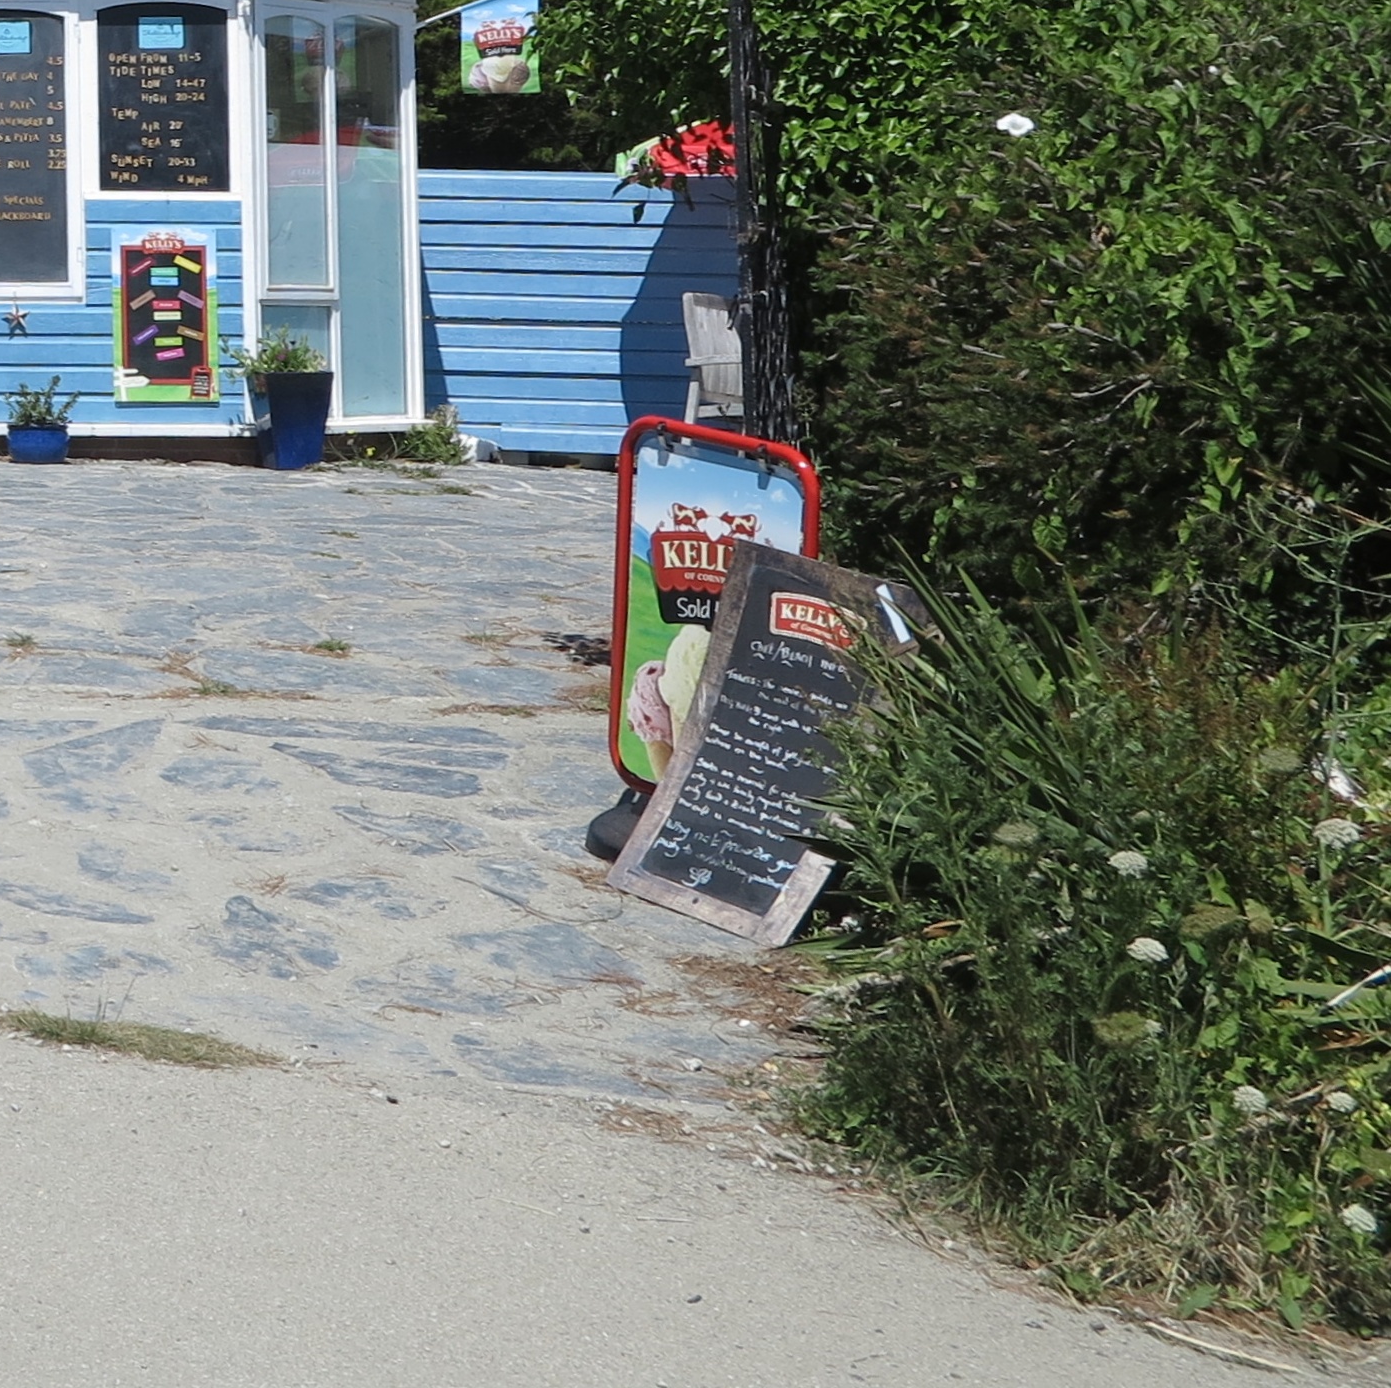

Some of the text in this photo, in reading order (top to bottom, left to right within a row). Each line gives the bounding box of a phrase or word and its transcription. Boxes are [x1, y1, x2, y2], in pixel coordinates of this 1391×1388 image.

[478, 28, 521, 43] KELLY'S
[108, 53, 202, 64] OPEN FROM 11-5
[109, 65, 175, 77] TIDE TIMES
[1, 72, 18, 82] THE
[20, 72, 39, 81] DAY
[46, 72, 54, 80] 4
[141, 79, 206, 88] LOW 14-47
[47, 85, 54, 94] 5
[141, 93, 206, 104] HIGH 20-24
[111, 108, 139, 119] TEMP
[46, 116, 54, 125] 8
[141, 122, 161, 132] AIR
[14, 133, 40, 143] PITTA
[141, 137, 161, 148] SEA
[7, 160, 30, 169] ROLL
[111, 154, 196, 167] SUNSET 20-33
[110, 172, 138, 183] WIND
[177, 174, 184, 183] 4
[3, 195, 44, 205] SPECIALS
[144, 240, 182, 249] KELLY'S
[661, 539, 734, 569] KELL
[684, 570, 696, 580] OF
[676, 596, 711, 618] Sold
